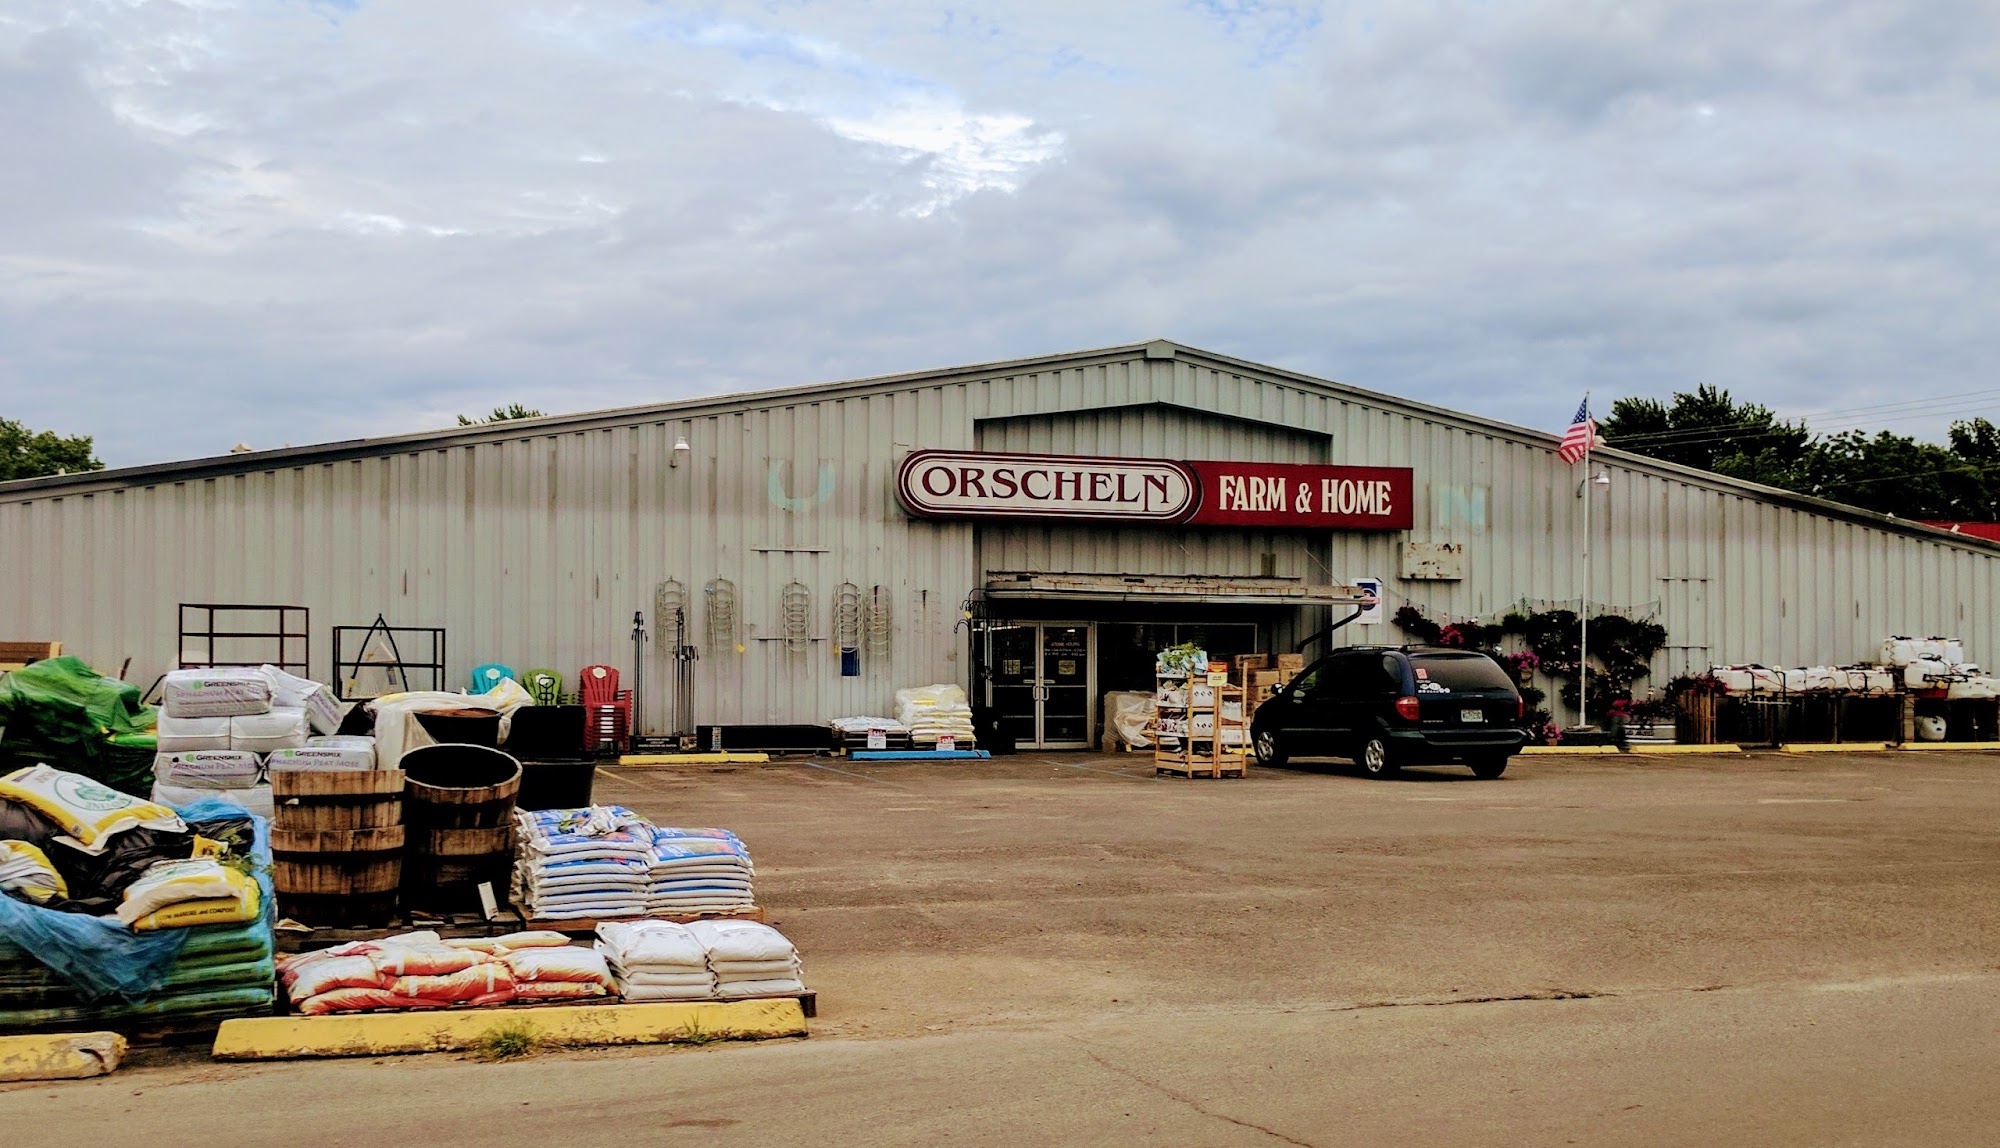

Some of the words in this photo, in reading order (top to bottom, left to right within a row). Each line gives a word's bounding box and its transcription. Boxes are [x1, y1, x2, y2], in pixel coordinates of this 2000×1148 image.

[921, 465, 1170, 512] ORSCHELN
[1219, 475, 1287, 512] FARM
[1295, 482, 1312, 513] &
[1321, 478, 1392, 516] HOME
